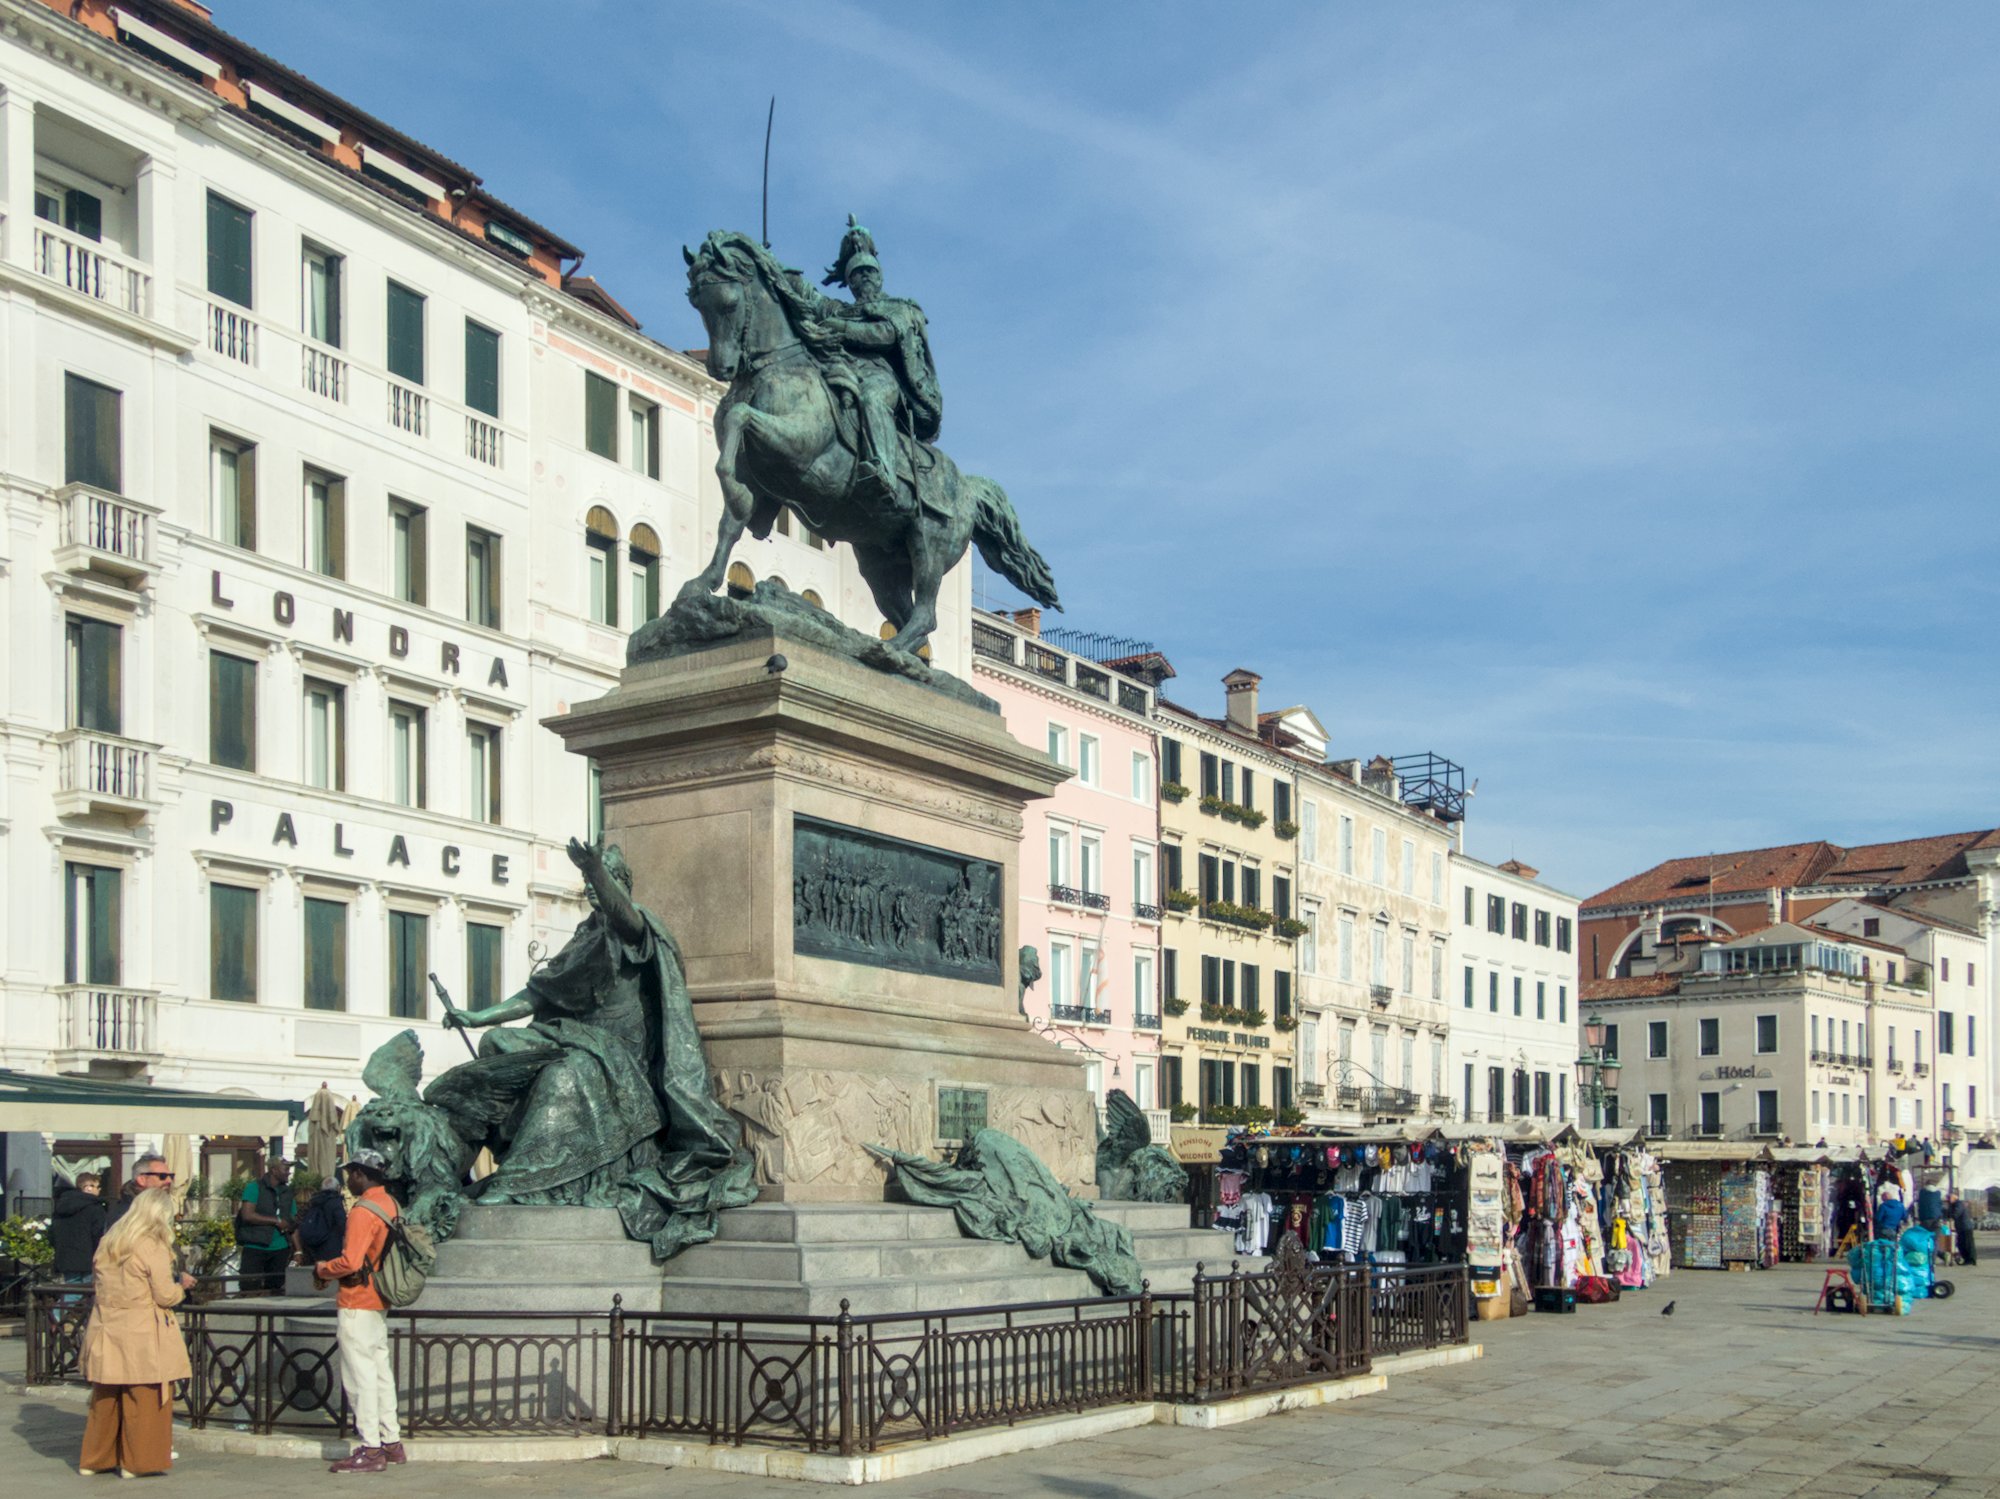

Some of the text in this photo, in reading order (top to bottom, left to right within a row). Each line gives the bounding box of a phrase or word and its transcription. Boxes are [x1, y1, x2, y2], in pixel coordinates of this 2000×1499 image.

[212, 570, 509, 688] LONDRA
[211, 800, 509, 884] PALACE
[1187, 1026, 1230, 1044] PENSIONE
[1180, 1138, 1213, 1148] PENSIONE
[1180, 1152, 1213, 1160] WILDNER
